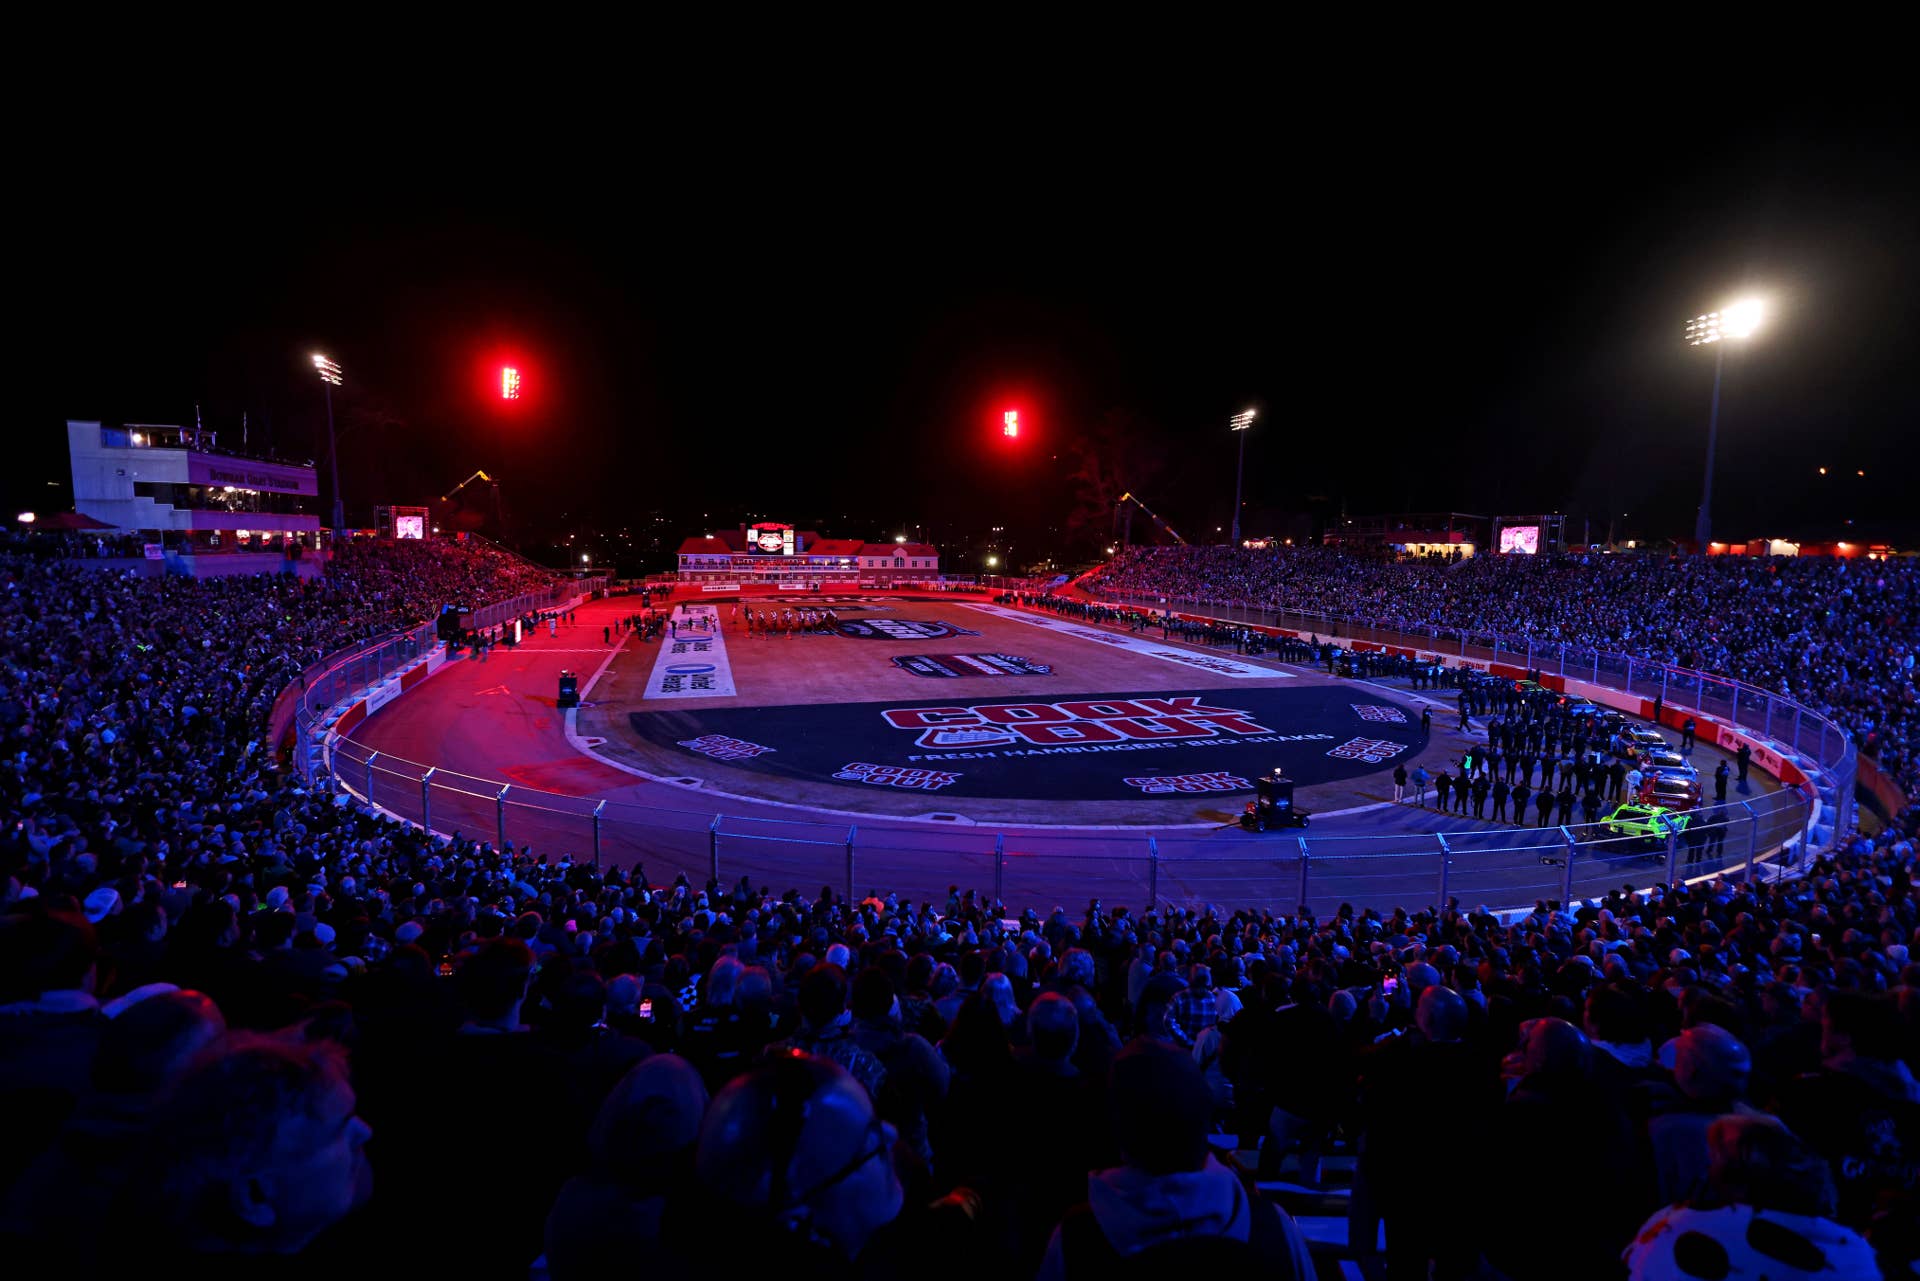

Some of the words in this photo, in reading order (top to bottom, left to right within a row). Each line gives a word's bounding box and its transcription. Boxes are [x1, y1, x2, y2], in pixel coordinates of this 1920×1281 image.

[881, 697, 1254, 729] COOK
[1007, 711, 1276, 745] OUT
[907, 751, 996, 762] FRESH
[842, 762, 963, 783] COOK
[1123, 771, 1248, 787] COOK
[862, 774, 955, 790] OUT
[1174, 778, 1255, 793] OUT
